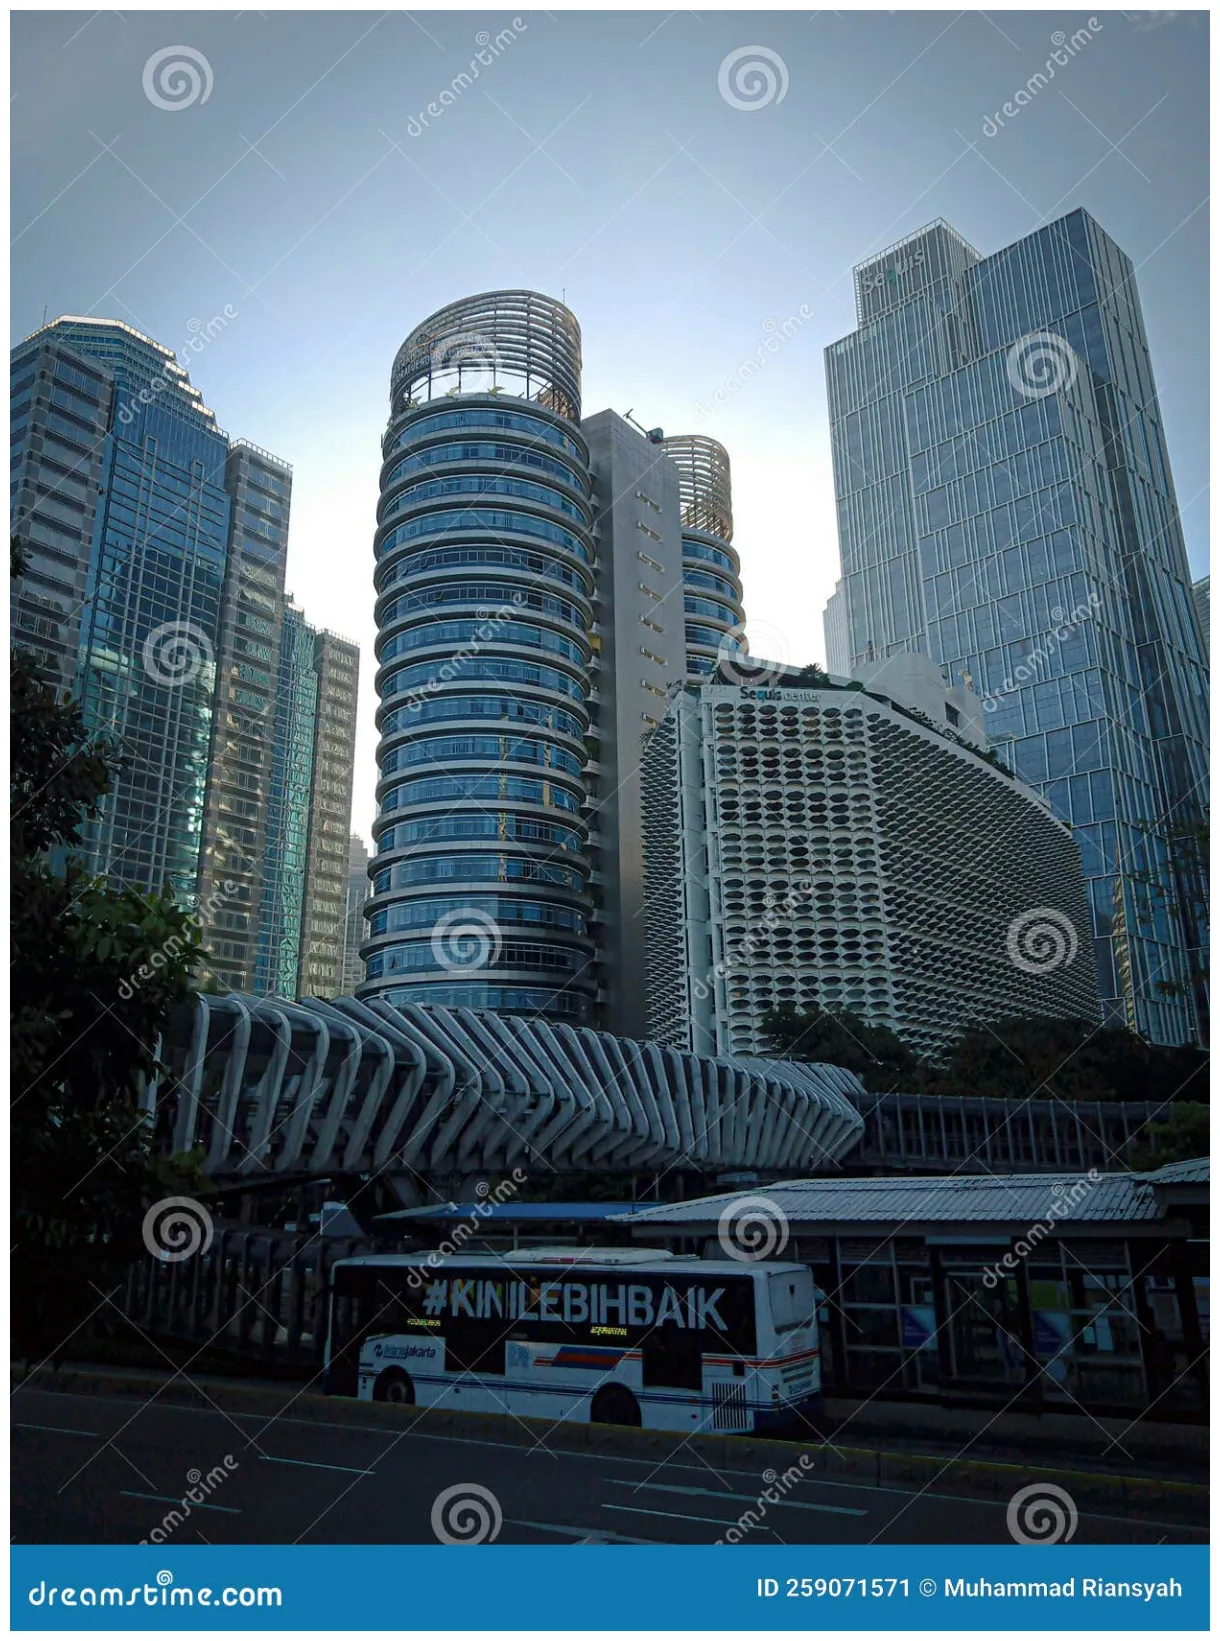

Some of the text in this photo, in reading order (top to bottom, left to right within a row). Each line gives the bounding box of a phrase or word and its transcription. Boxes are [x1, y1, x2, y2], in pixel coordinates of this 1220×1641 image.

[860, 249, 925, 295] Sequis
[740, 686, 782, 703] Sequis
[421, 1278, 729, 1332] #KINILEBIHBAIK
[383, 1344, 436, 1359] transjakarta
